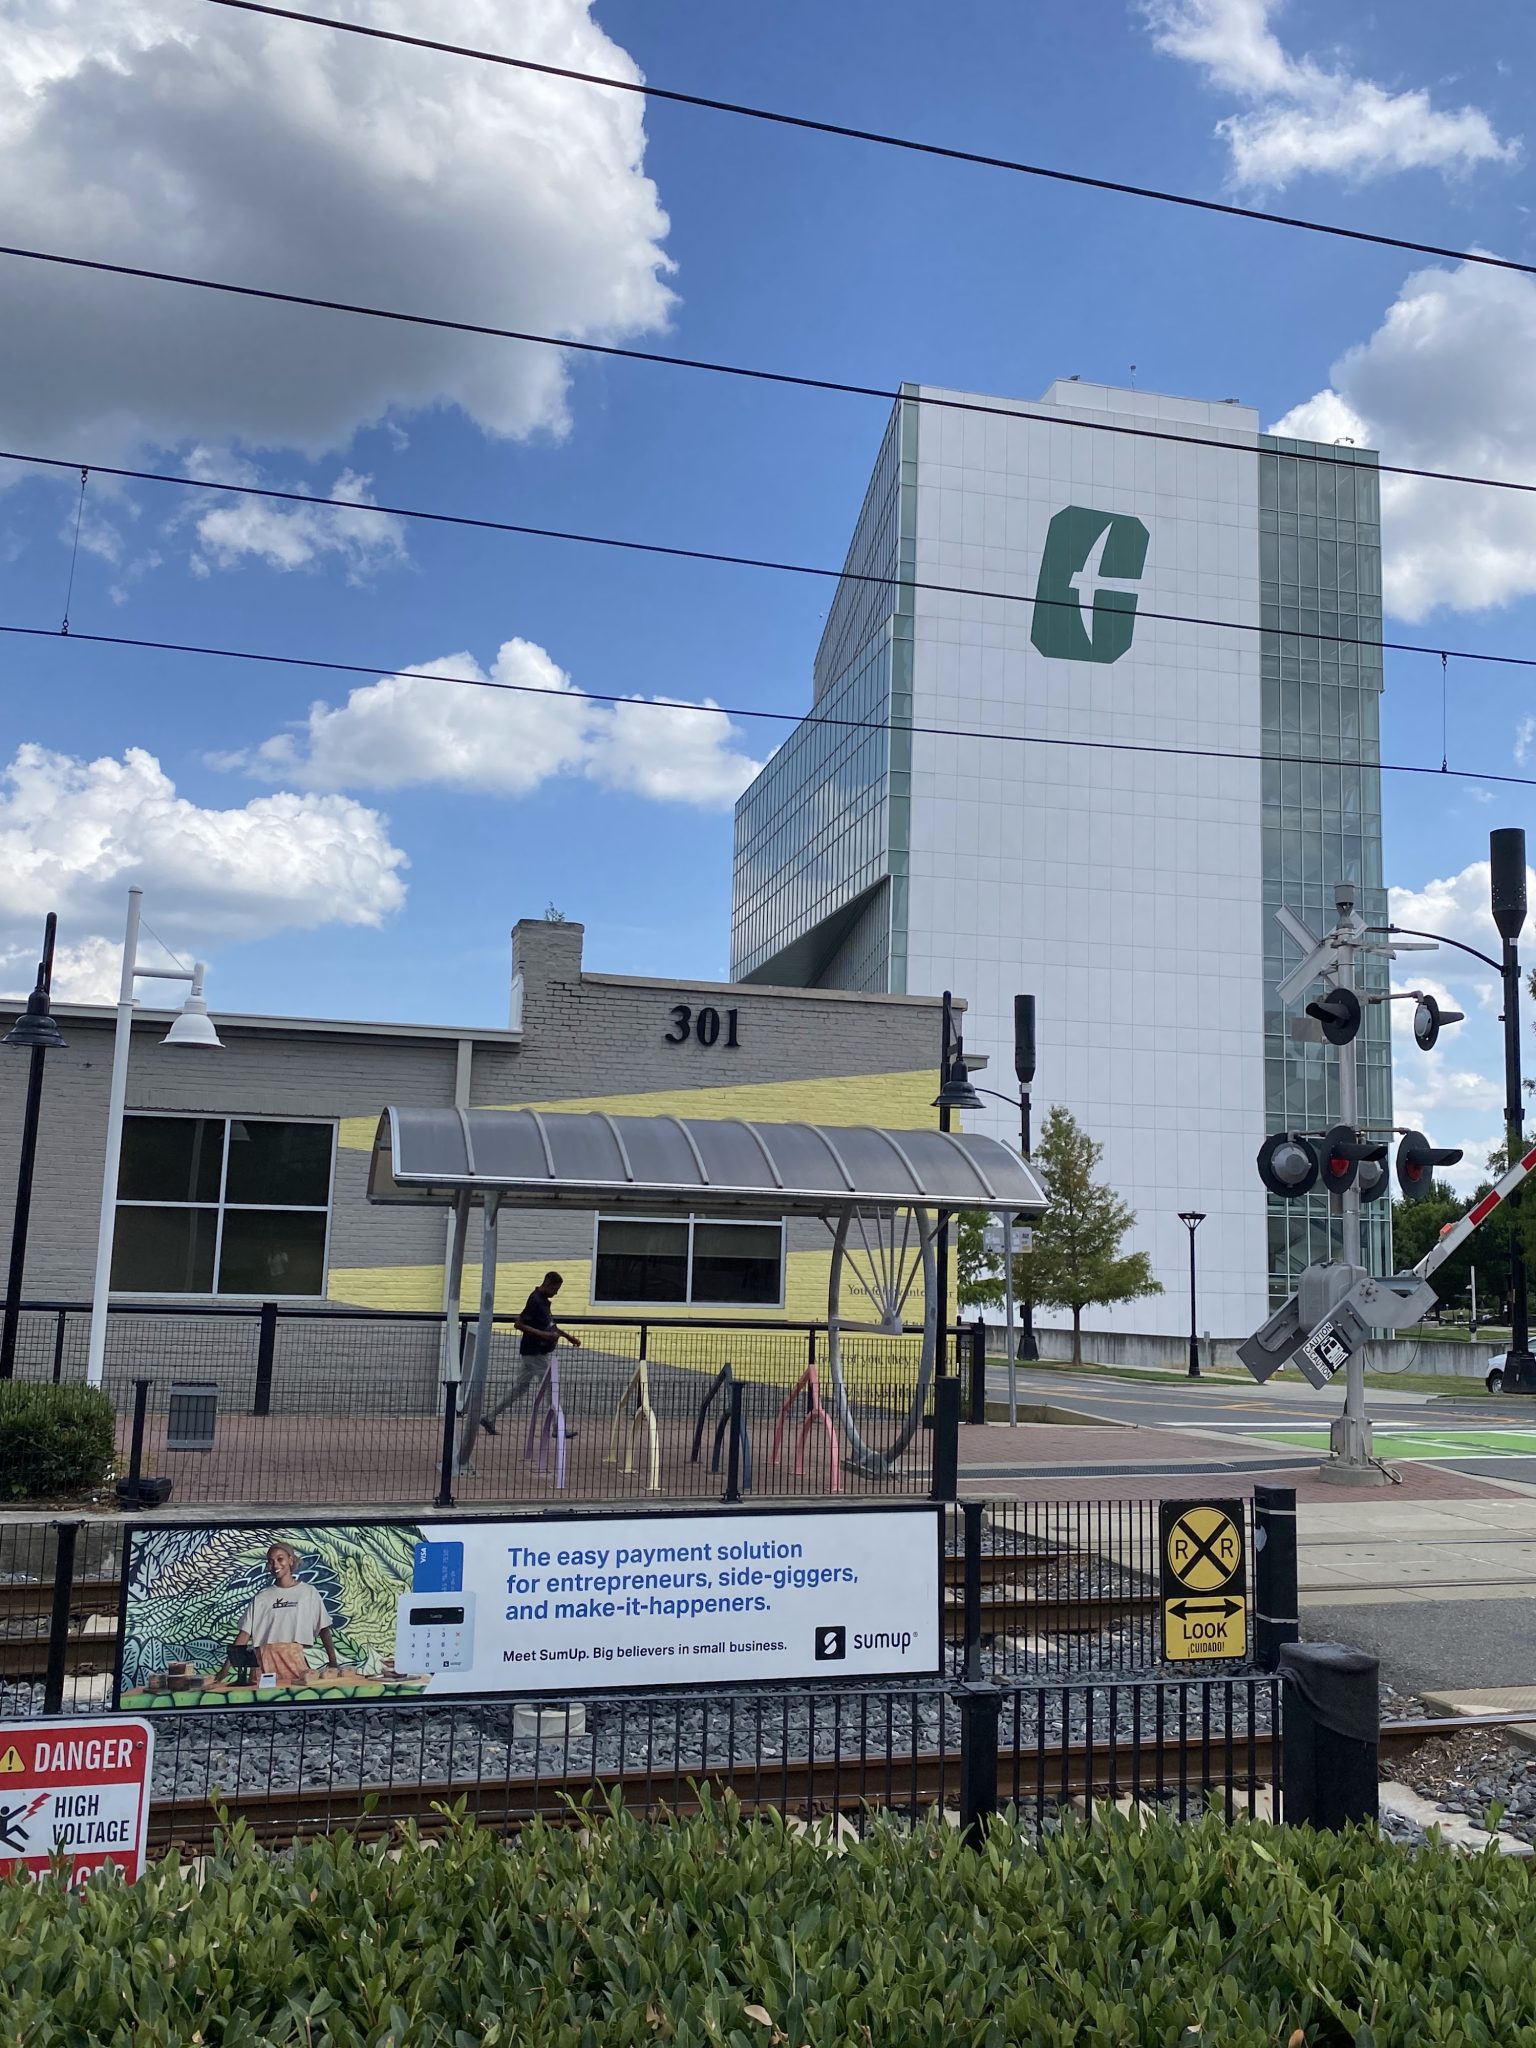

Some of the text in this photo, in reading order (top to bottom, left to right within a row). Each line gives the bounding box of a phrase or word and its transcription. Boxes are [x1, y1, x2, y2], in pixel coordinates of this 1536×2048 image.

[665, 1005, 741, 1047] 301
[1305, 1324, 1332, 1353] CAUTION
[1310, 1351, 1332, 1379] CAUTION
[508, 1540, 803, 1569] The easy payment solution
[507, 1565, 859, 1595] for entrepreneurs, side-giggers,
[505, 1595, 771, 1620] and make-it-happeners.
[1183, 1622, 1228, 1640] LOOK
[503, 1640, 787, 1662] Meet SumUp. Big believers in small business.
[34, 1738, 133, 1773] DANGER
[54, 1794, 99, 1818] HIGH
[52, 1820, 130, 1846] VOLTAGE
